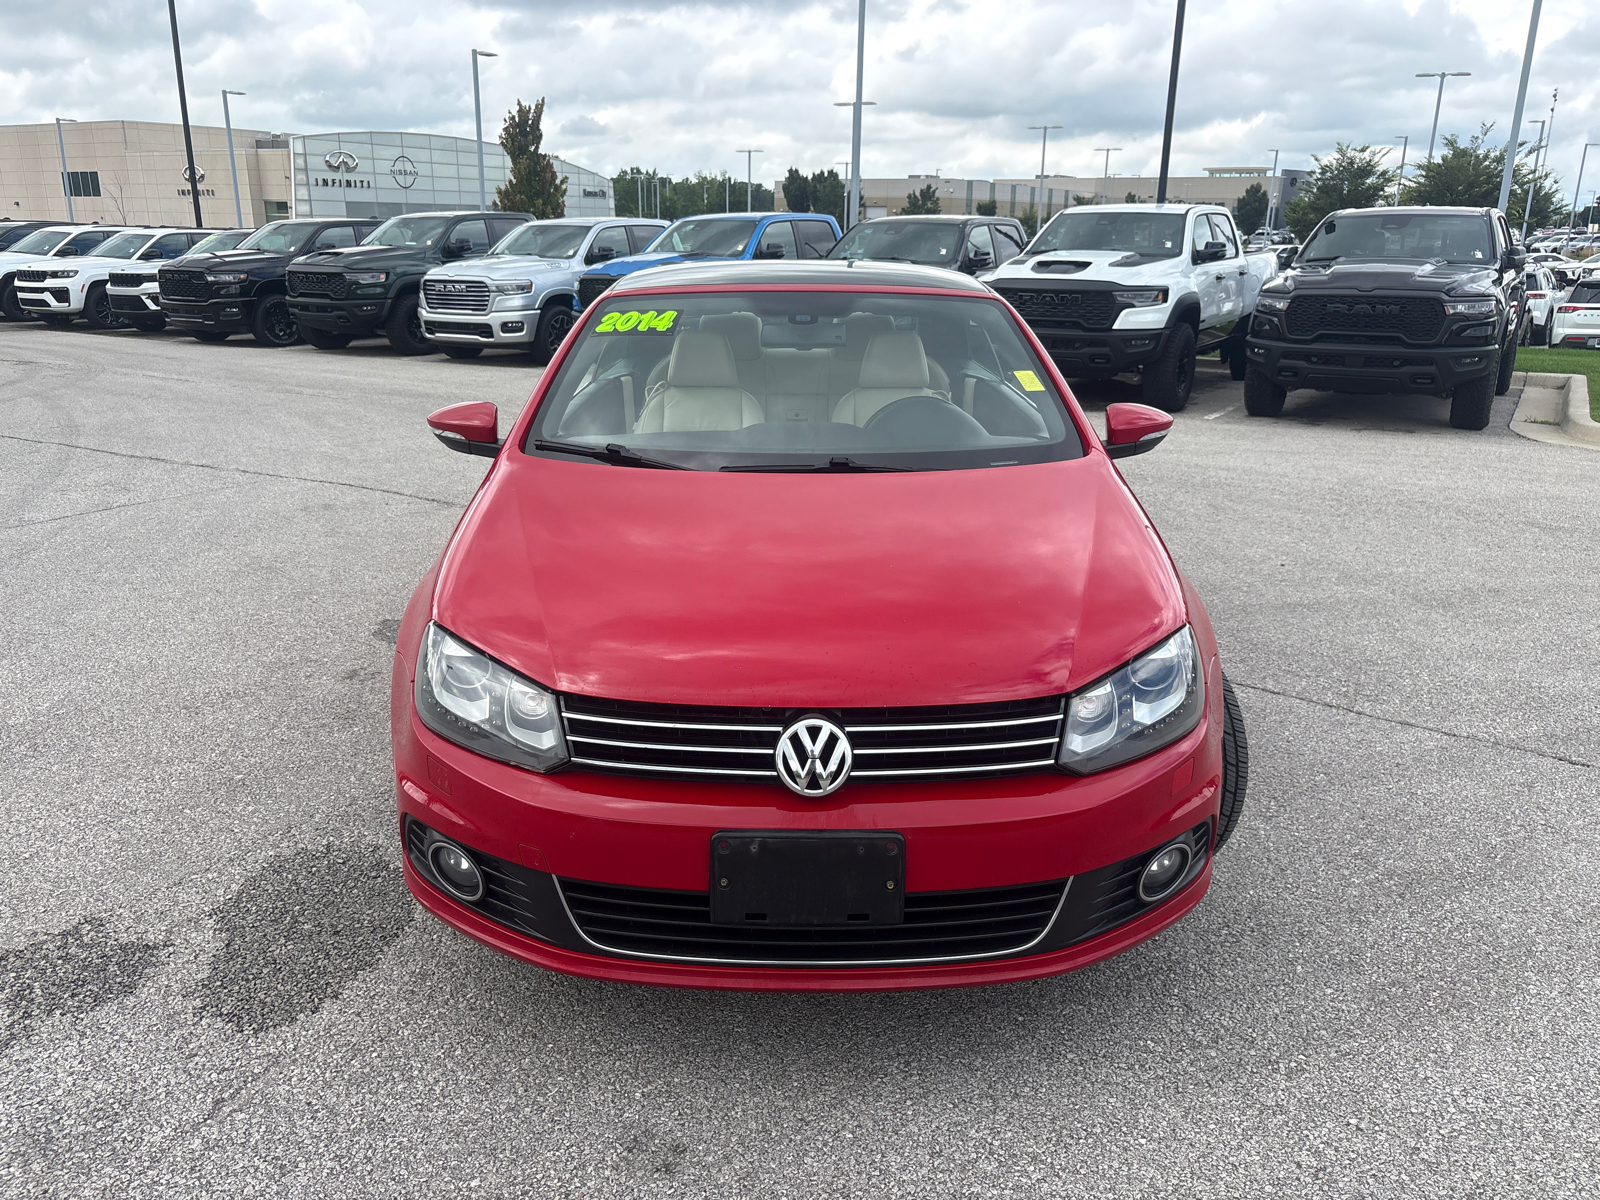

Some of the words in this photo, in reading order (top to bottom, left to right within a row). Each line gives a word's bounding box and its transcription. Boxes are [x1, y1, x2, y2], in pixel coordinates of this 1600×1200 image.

[315, 178, 370, 189] INFINITI
[434, 284, 467, 292] RAM
[1017, 293, 1081, 304] RAM
[1325, 303, 1400, 315] RAM
[595, 311, 678, 332] 2014
